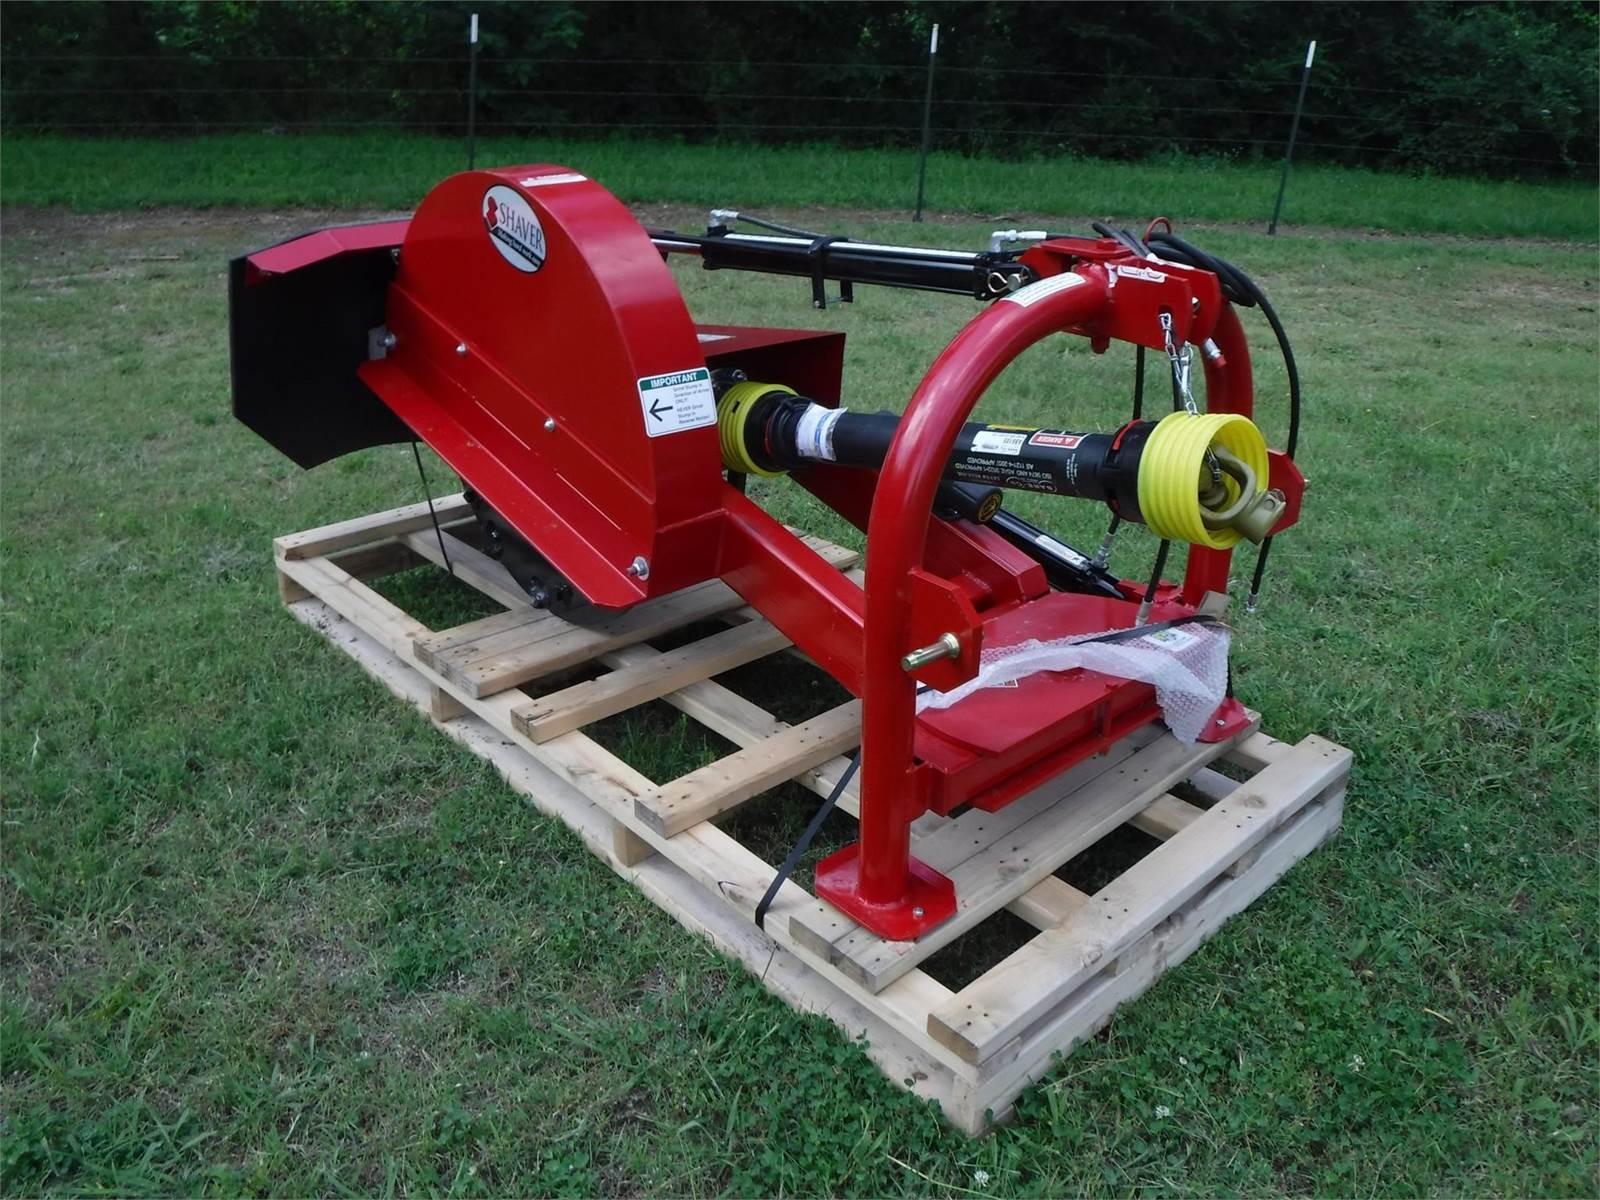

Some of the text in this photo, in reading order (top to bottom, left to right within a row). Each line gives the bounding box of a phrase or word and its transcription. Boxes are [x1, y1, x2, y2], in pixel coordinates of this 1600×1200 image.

[500, 203, 543, 252] SHAVER
[650, 372, 697, 388] IMPORTANT
[954, 462, 983, 471] APPROVED
[966, 457, 995, 466] APPROVED
